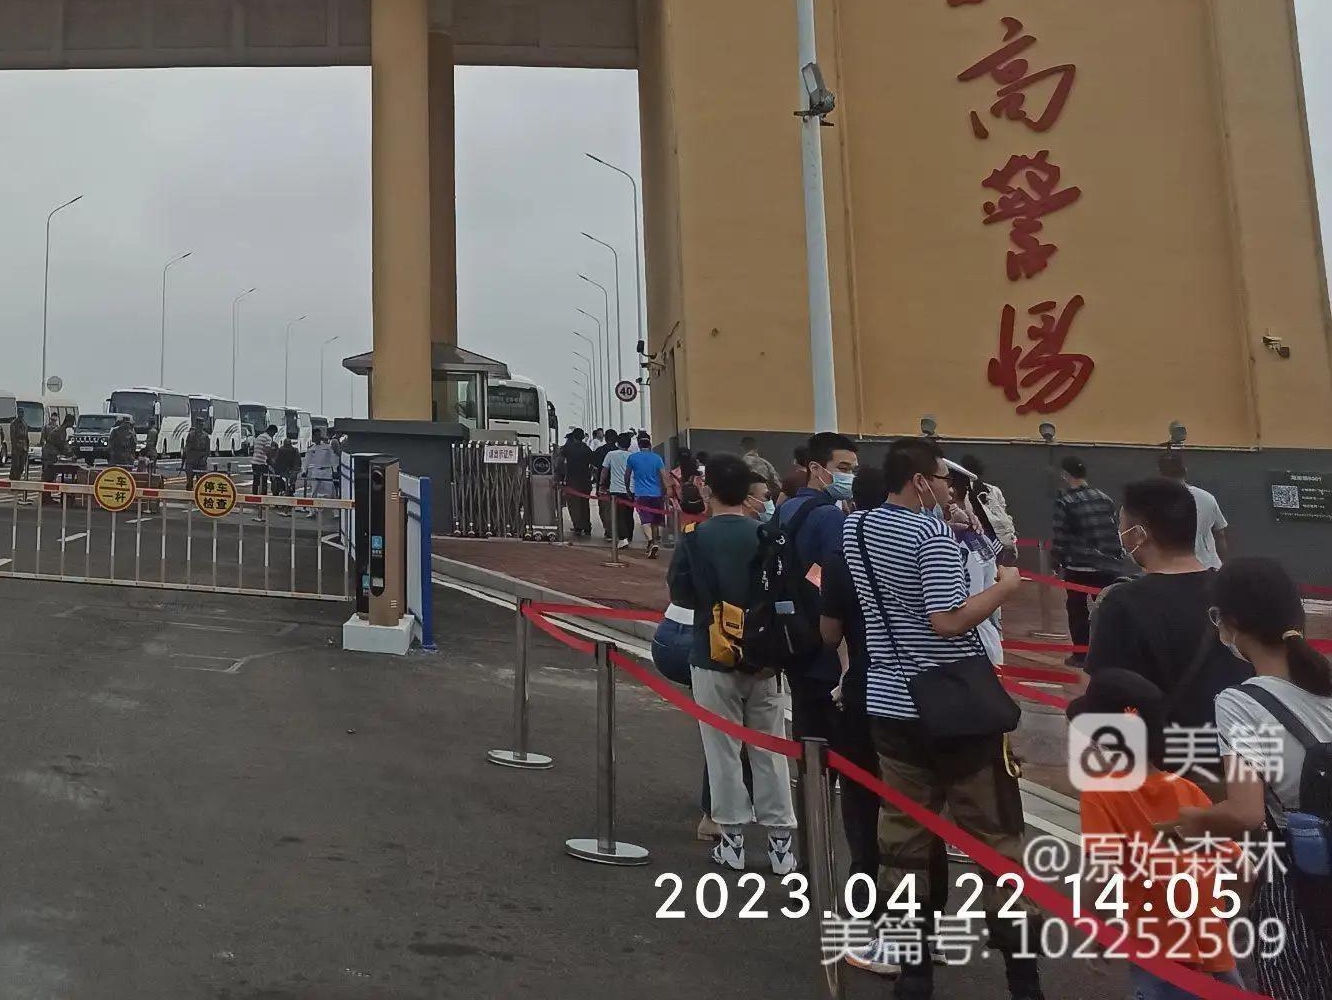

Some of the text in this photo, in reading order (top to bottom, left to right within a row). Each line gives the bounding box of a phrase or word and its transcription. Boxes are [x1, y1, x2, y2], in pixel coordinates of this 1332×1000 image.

[619, 386, 633, 396] 40
[104, 476, 127, 488] 一车
[204, 481, 228, 494] 停车
[102, 491, 127, 503] 一杆
[203, 497, 228, 510] 检查
